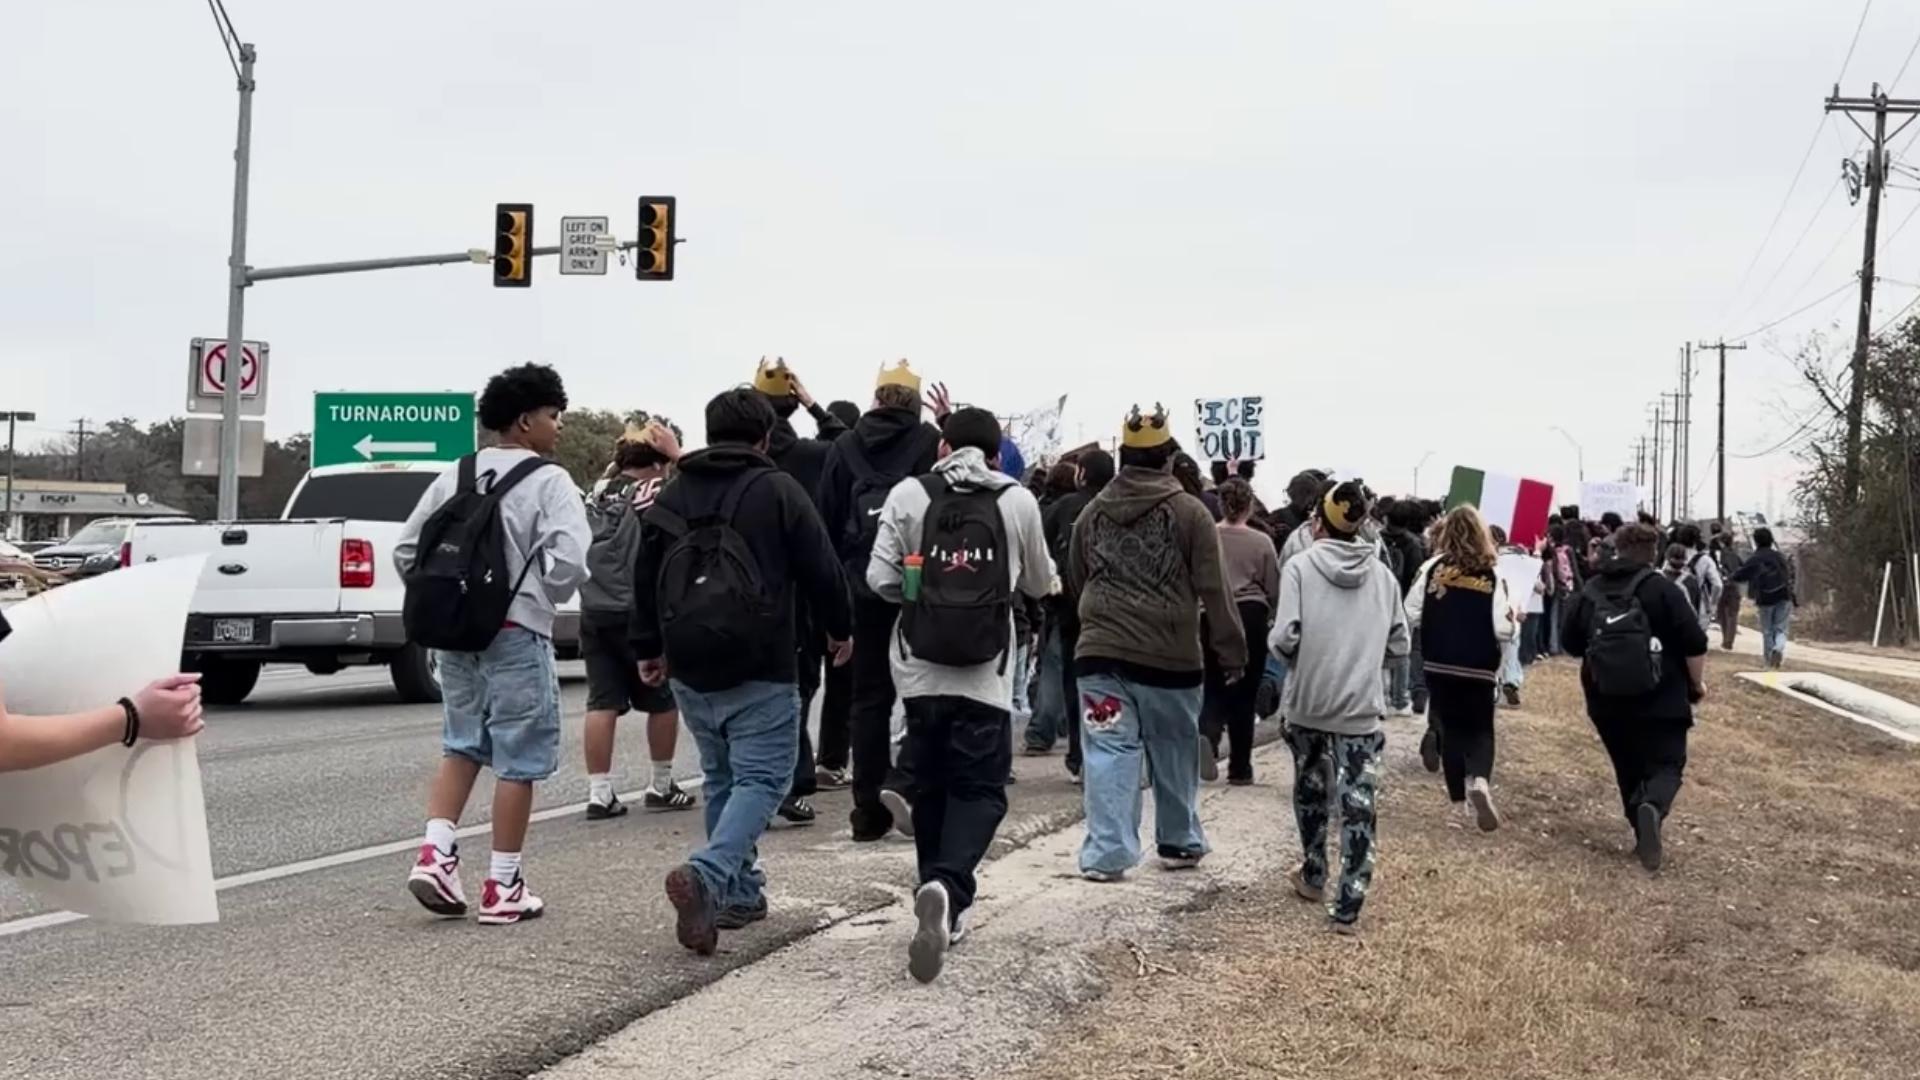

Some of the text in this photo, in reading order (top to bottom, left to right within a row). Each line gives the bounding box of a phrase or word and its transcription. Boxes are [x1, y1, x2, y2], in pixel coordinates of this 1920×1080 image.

[566, 222, 603, 232] LEFT ON
[571, 259, 595, 269] ONLY
[328, 405, 461, 422] TURNAROUND
[1203, 428, 1261, 460] OUT
